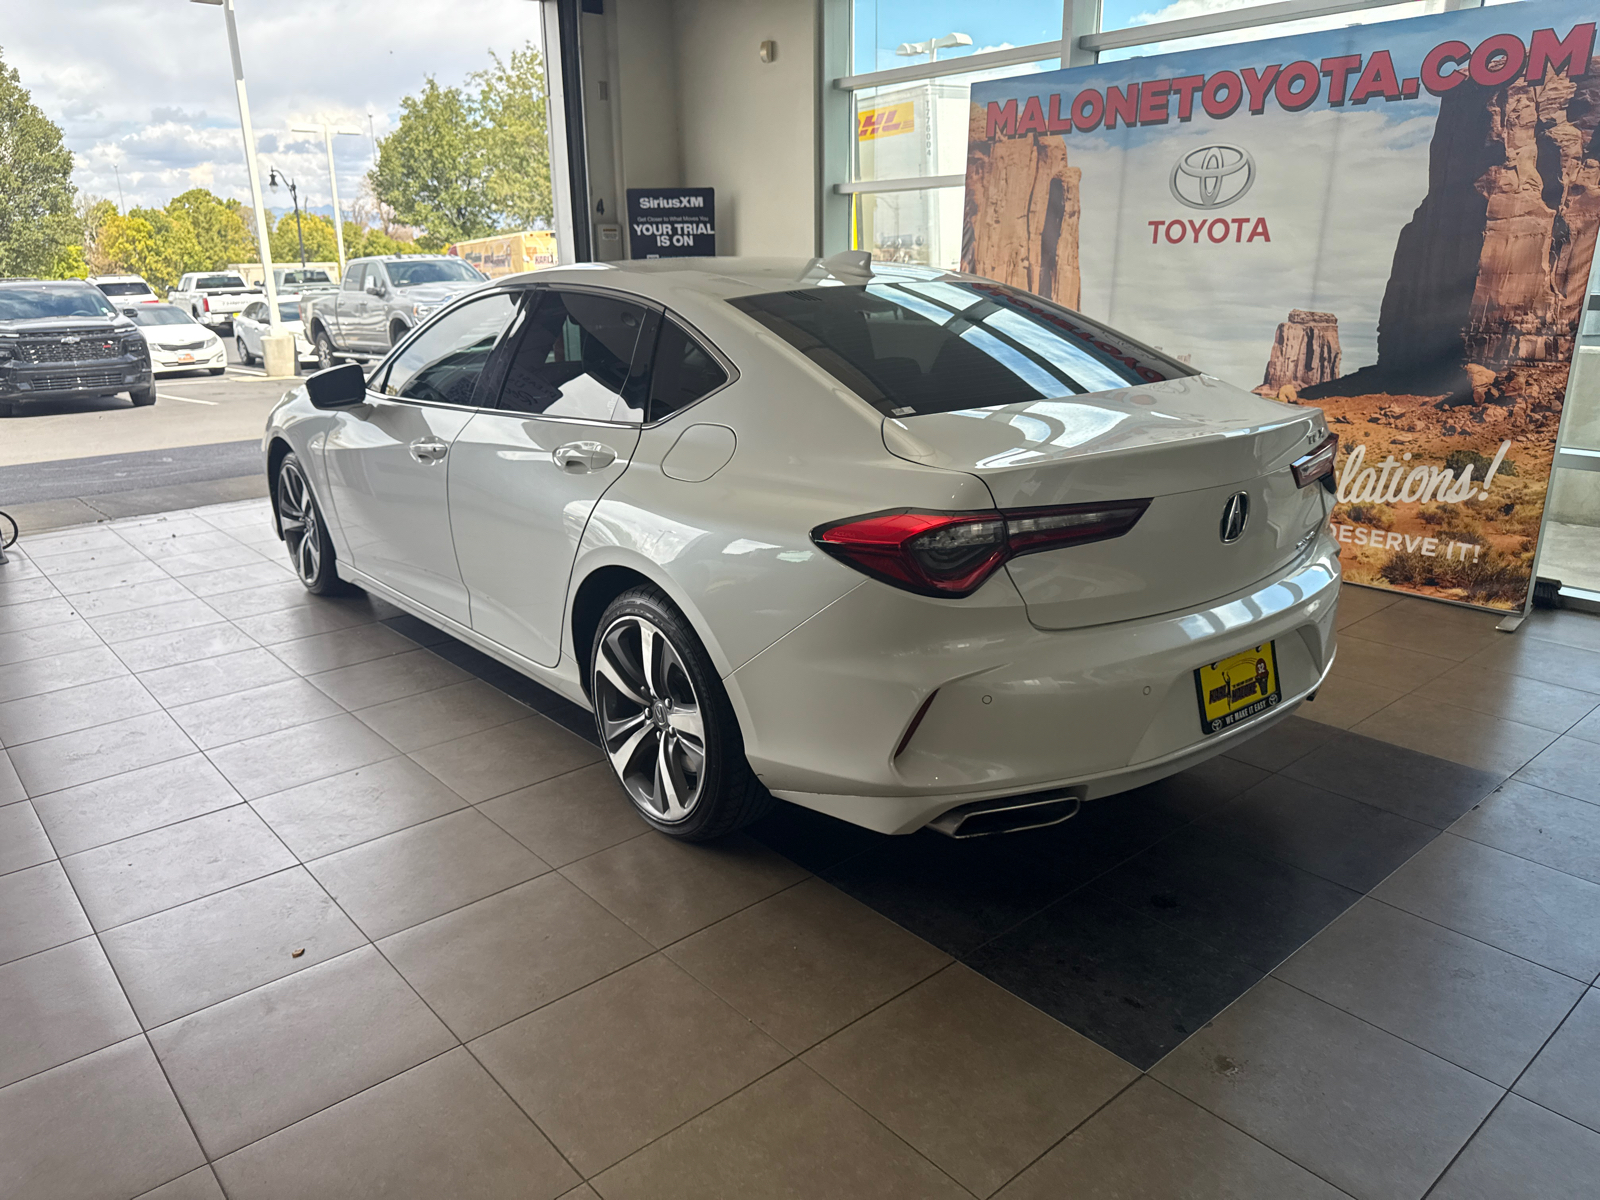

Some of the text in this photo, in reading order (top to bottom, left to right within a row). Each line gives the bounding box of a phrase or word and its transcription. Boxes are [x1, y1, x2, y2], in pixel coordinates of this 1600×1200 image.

[986, 22, 1598, 139] MALONETOYOTA.COM
[858, 109, 902, 137] HL
[924, 100, 932, 157] T776004
[596, 198, 605, 216] 4
[639, 196, 704, 209] SiriusXM
[633, 223, 715, 236] YOUR TRIAL
[656, 235, 694, 247] IS ON
[1147, 217, 1271, 244] TOYOTA
[1336, 440, 1512, 504] lations!
[1446, 541, 1481, 564] IT!
[1257, 662, 1266, 674] 32
[1225, 700, 1267, 725] WE MAKE IT EASY
